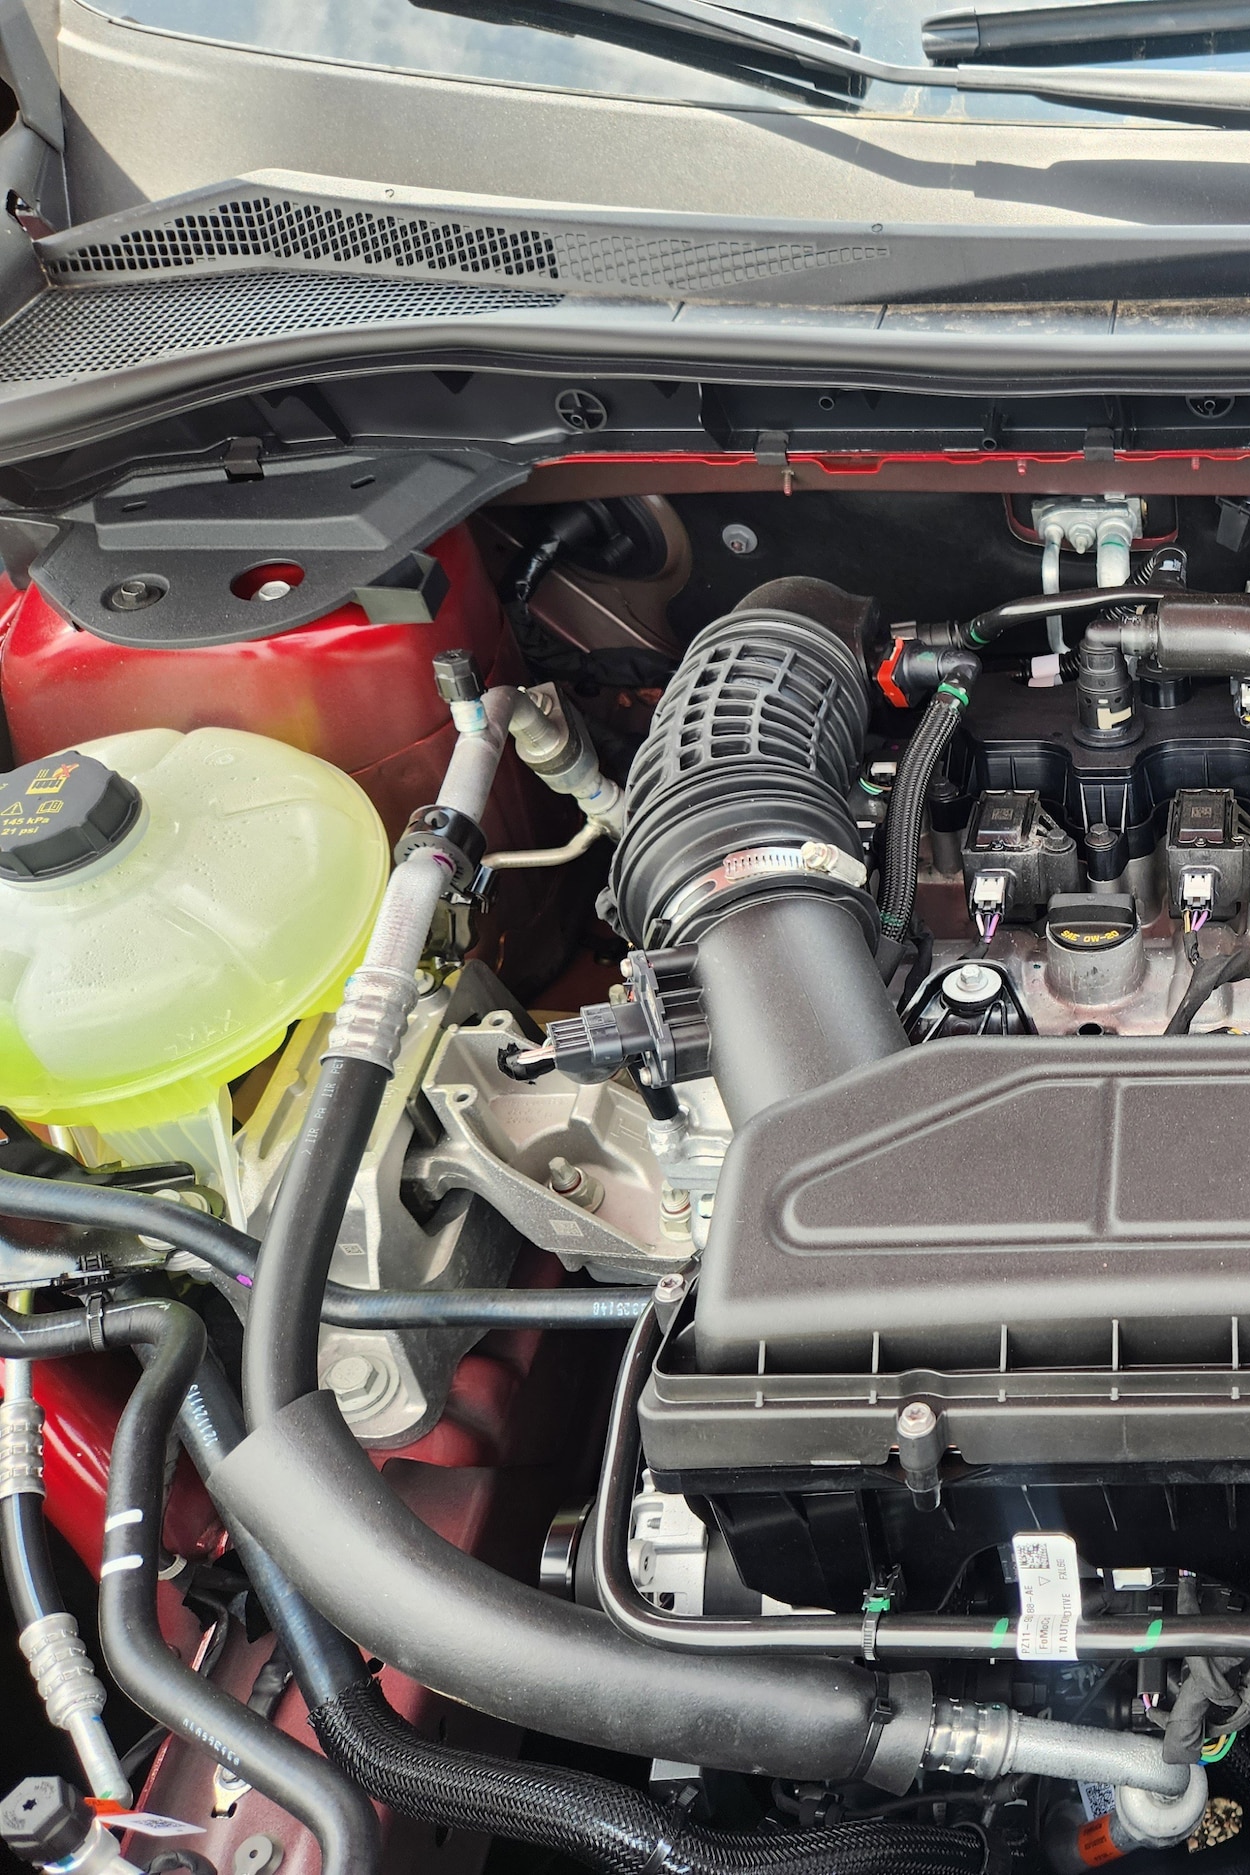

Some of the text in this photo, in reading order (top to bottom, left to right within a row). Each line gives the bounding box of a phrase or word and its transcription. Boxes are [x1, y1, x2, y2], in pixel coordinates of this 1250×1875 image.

[2, 816, 50, 826] 145 kPa
[1, 826, 40, 836] 21 psi
[1060, 930, 1080, 942] SAE
[312, 1105, 326, 1120] PA
[329, 1056, 344, 1075] PET
[1059, 1593, 1072, 1643] AUTOOTIVE
